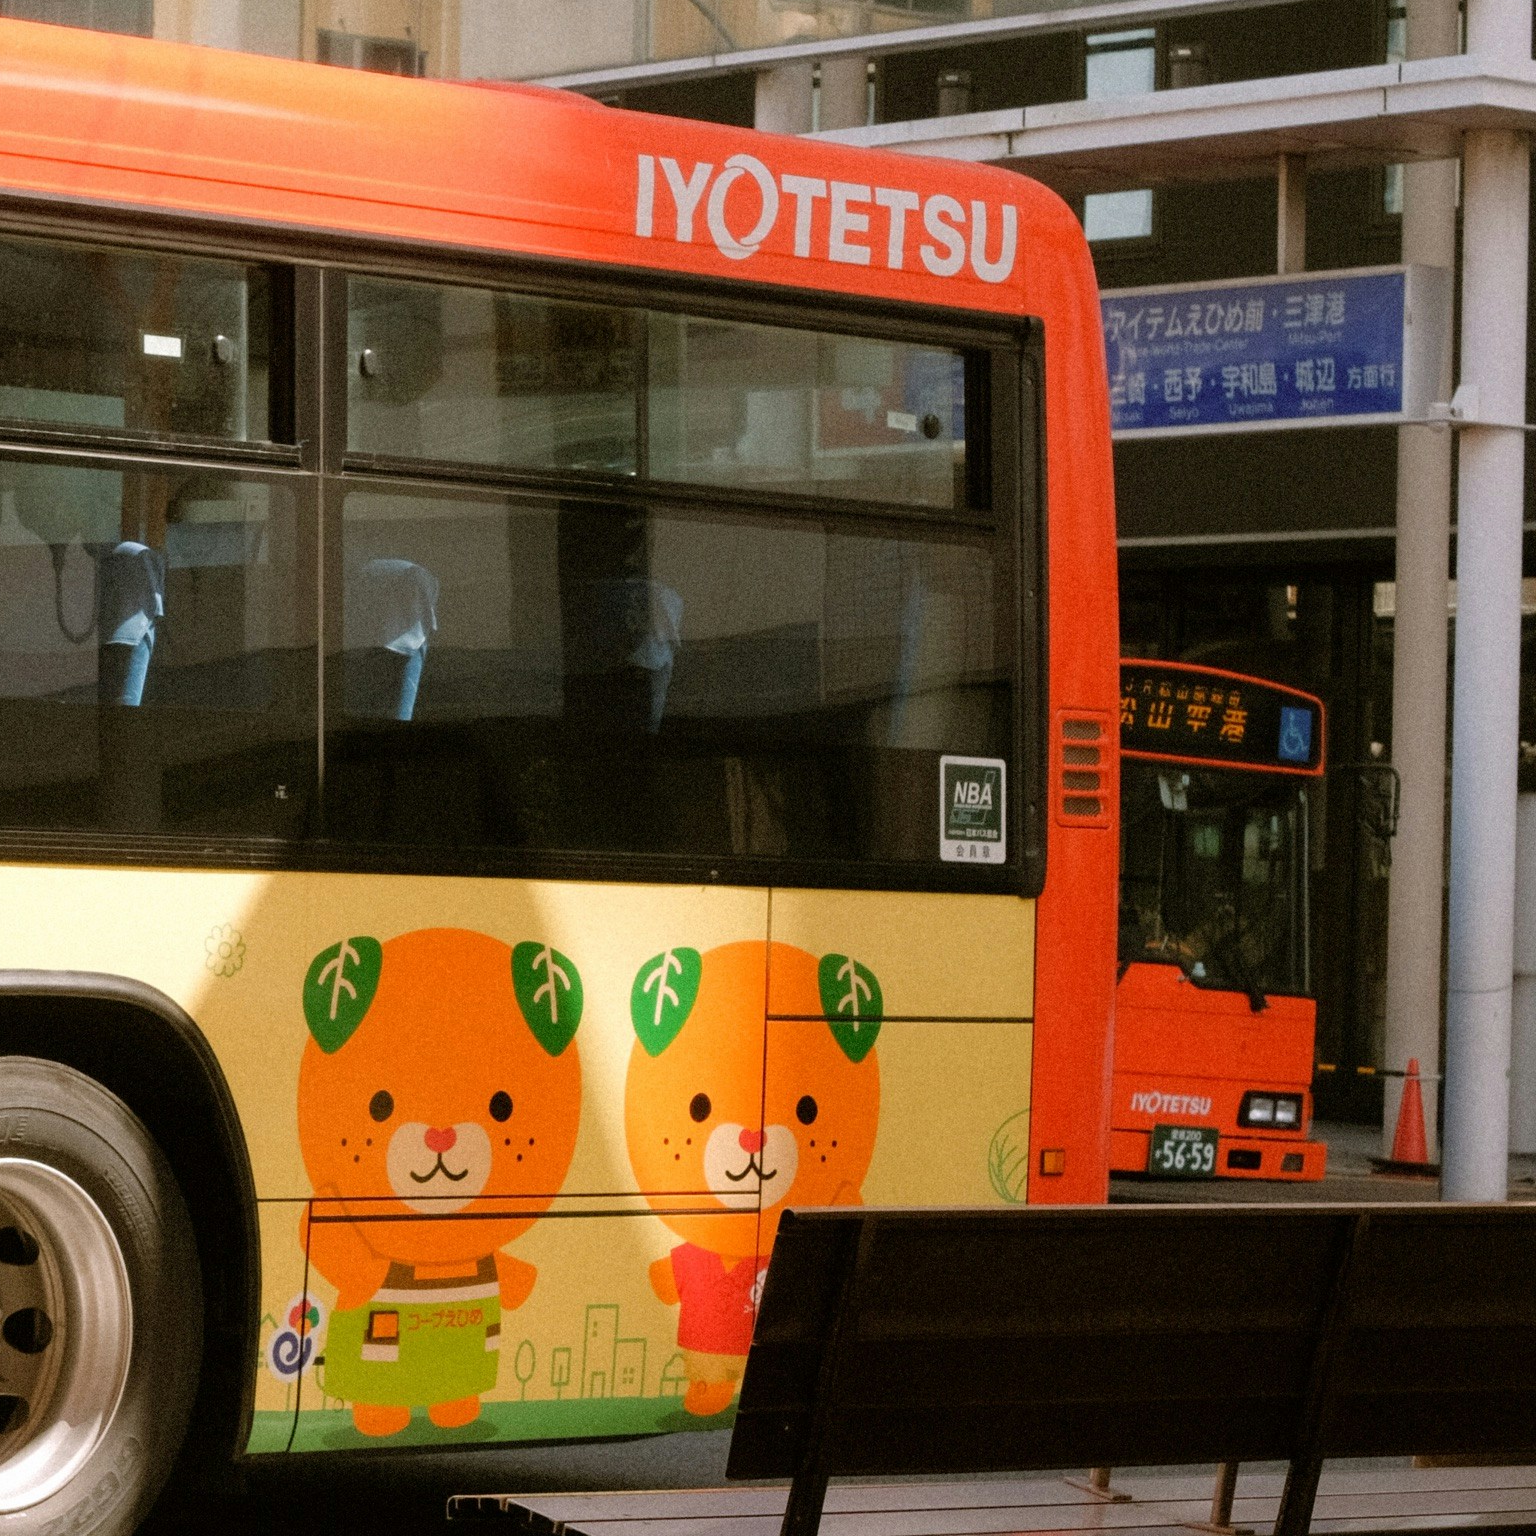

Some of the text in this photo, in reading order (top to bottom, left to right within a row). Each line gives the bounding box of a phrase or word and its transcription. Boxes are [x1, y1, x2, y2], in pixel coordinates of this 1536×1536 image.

[635, 154, 1017, 283] IYOTETSU
[953, 781, 993, 805] NBA
[1130, 1091, 1212, 1116] IYOTETSU
